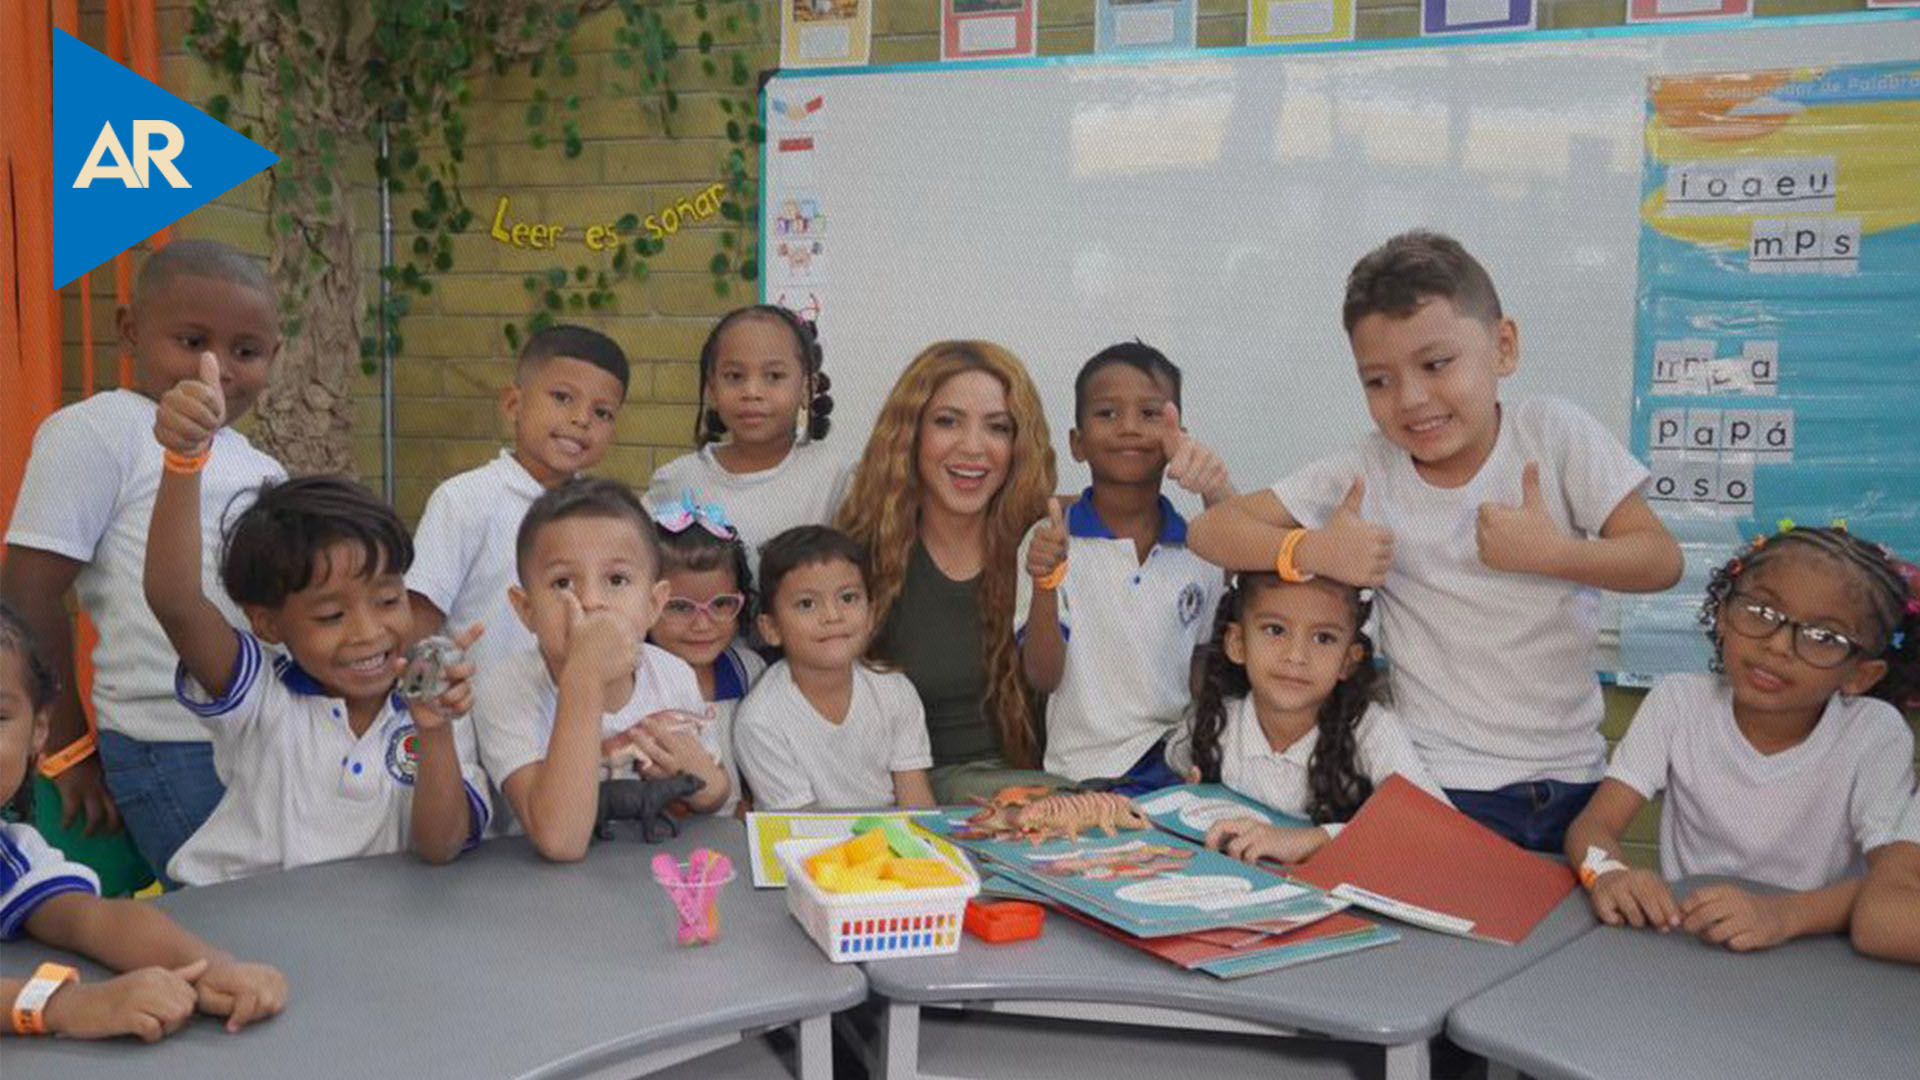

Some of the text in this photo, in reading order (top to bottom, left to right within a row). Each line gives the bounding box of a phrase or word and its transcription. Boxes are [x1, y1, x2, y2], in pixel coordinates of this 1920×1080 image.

[491, 183, 725, 250] Leer es soñar
